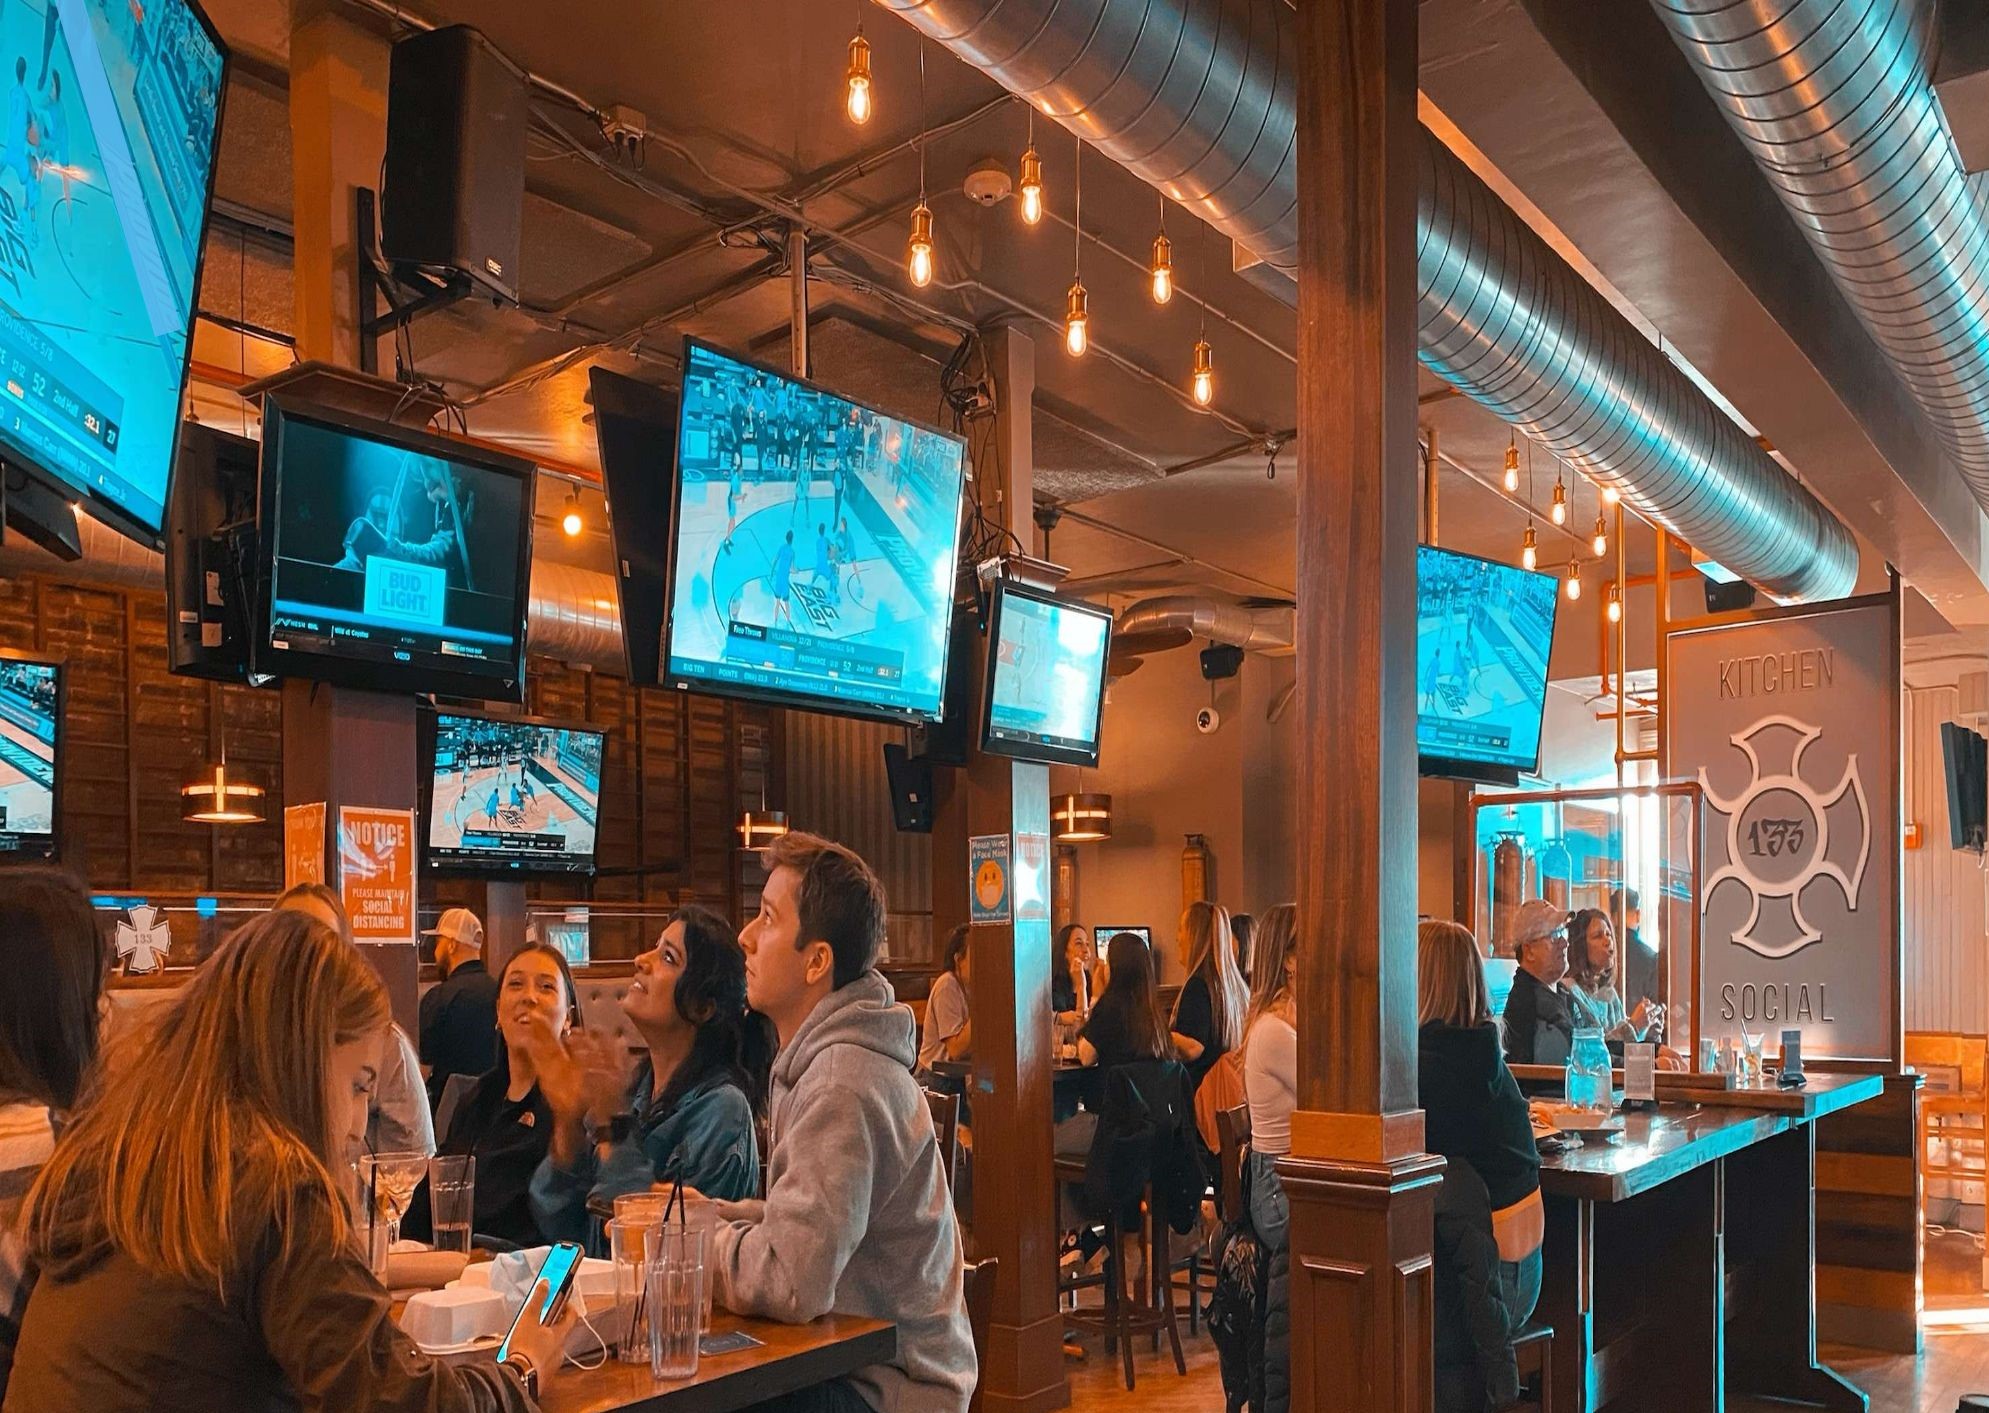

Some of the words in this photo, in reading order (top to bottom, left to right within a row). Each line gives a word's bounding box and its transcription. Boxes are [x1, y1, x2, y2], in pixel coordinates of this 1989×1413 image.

[32, 370, 46, 397] 52
[14, 416, 20, 431] 3
[389, 571, 421, 592] BUD
[793, 582, 833, 632] EAST
[812, 587, 840, 619] BIG
[1719, 646, 1834, 699] KITCHEN
[350, 821, 405, 847] NOTICE
[1747, 818, 1804, 857] 133
[976, 850, 991, 859] Face
[991, 849, 1007, 858] Mask
[352, 887, 374, 899] PLEASE
[362, 900, 393, 914] SOCIAL
[352, 914, 405, 929] DISTANCING
[134, 933, 153, 944] 133
[1720, 982, 1835, 1022] SOCIAL
